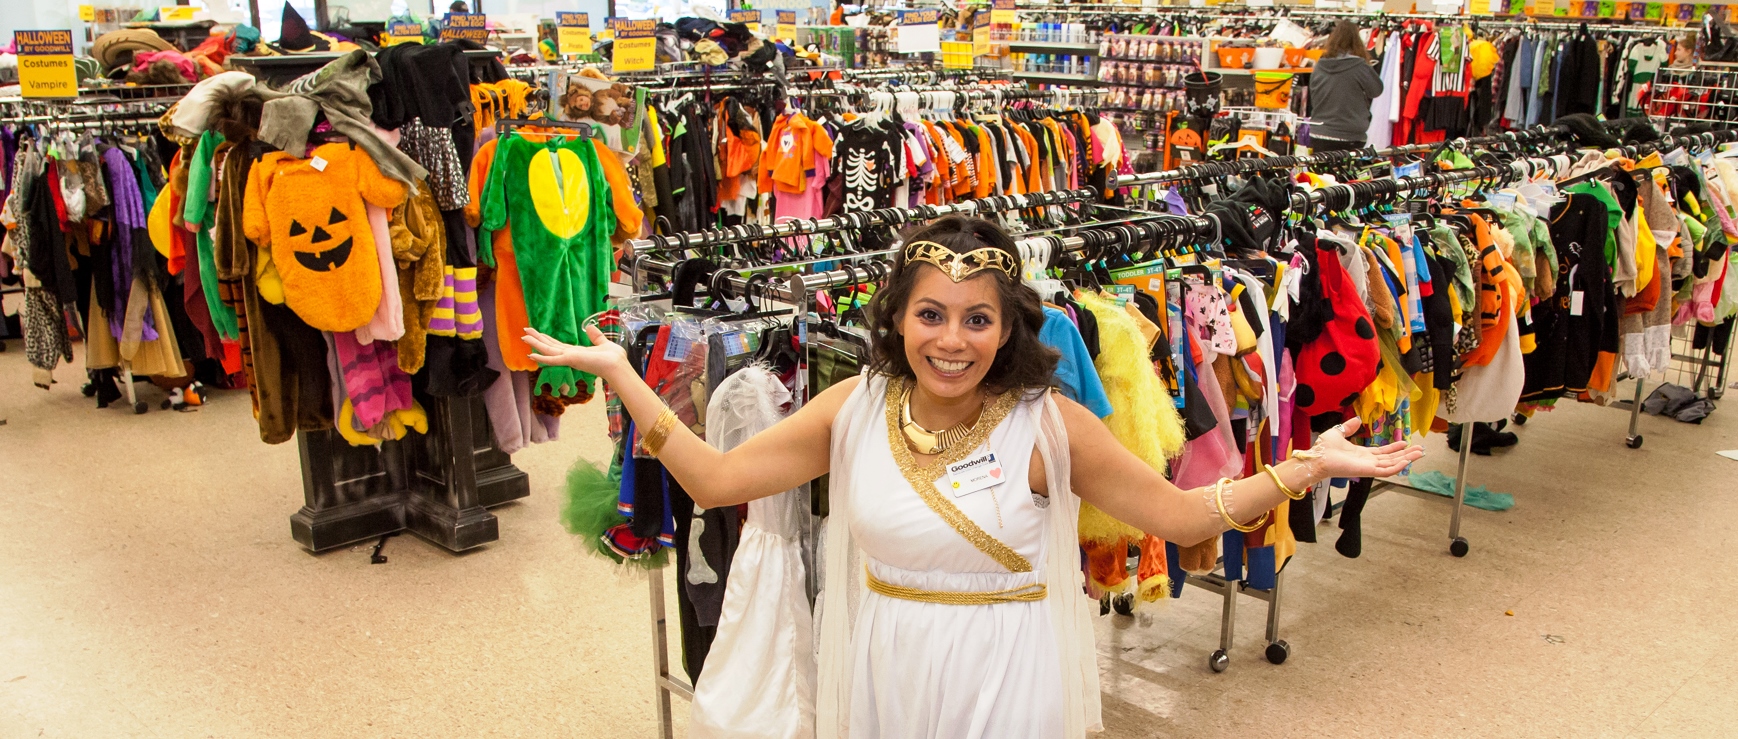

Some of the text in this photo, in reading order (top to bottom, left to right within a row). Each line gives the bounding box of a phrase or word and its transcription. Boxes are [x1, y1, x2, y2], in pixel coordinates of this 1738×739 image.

[615, 20, 655, 30] HALLOWEEN
[16, 31, 71, 45] HALLOWEEN
[441, 30, 489, 39] HALLOWEEN
[23, 59, 68, 68] Costumes
[624, 57, 644, 65] Witch
[29, 80, 68, 90] Vampire
[1117, 265, 1162, 279] TODDLER 3T-4T
[951, 456, 988, 472] Goodwill
